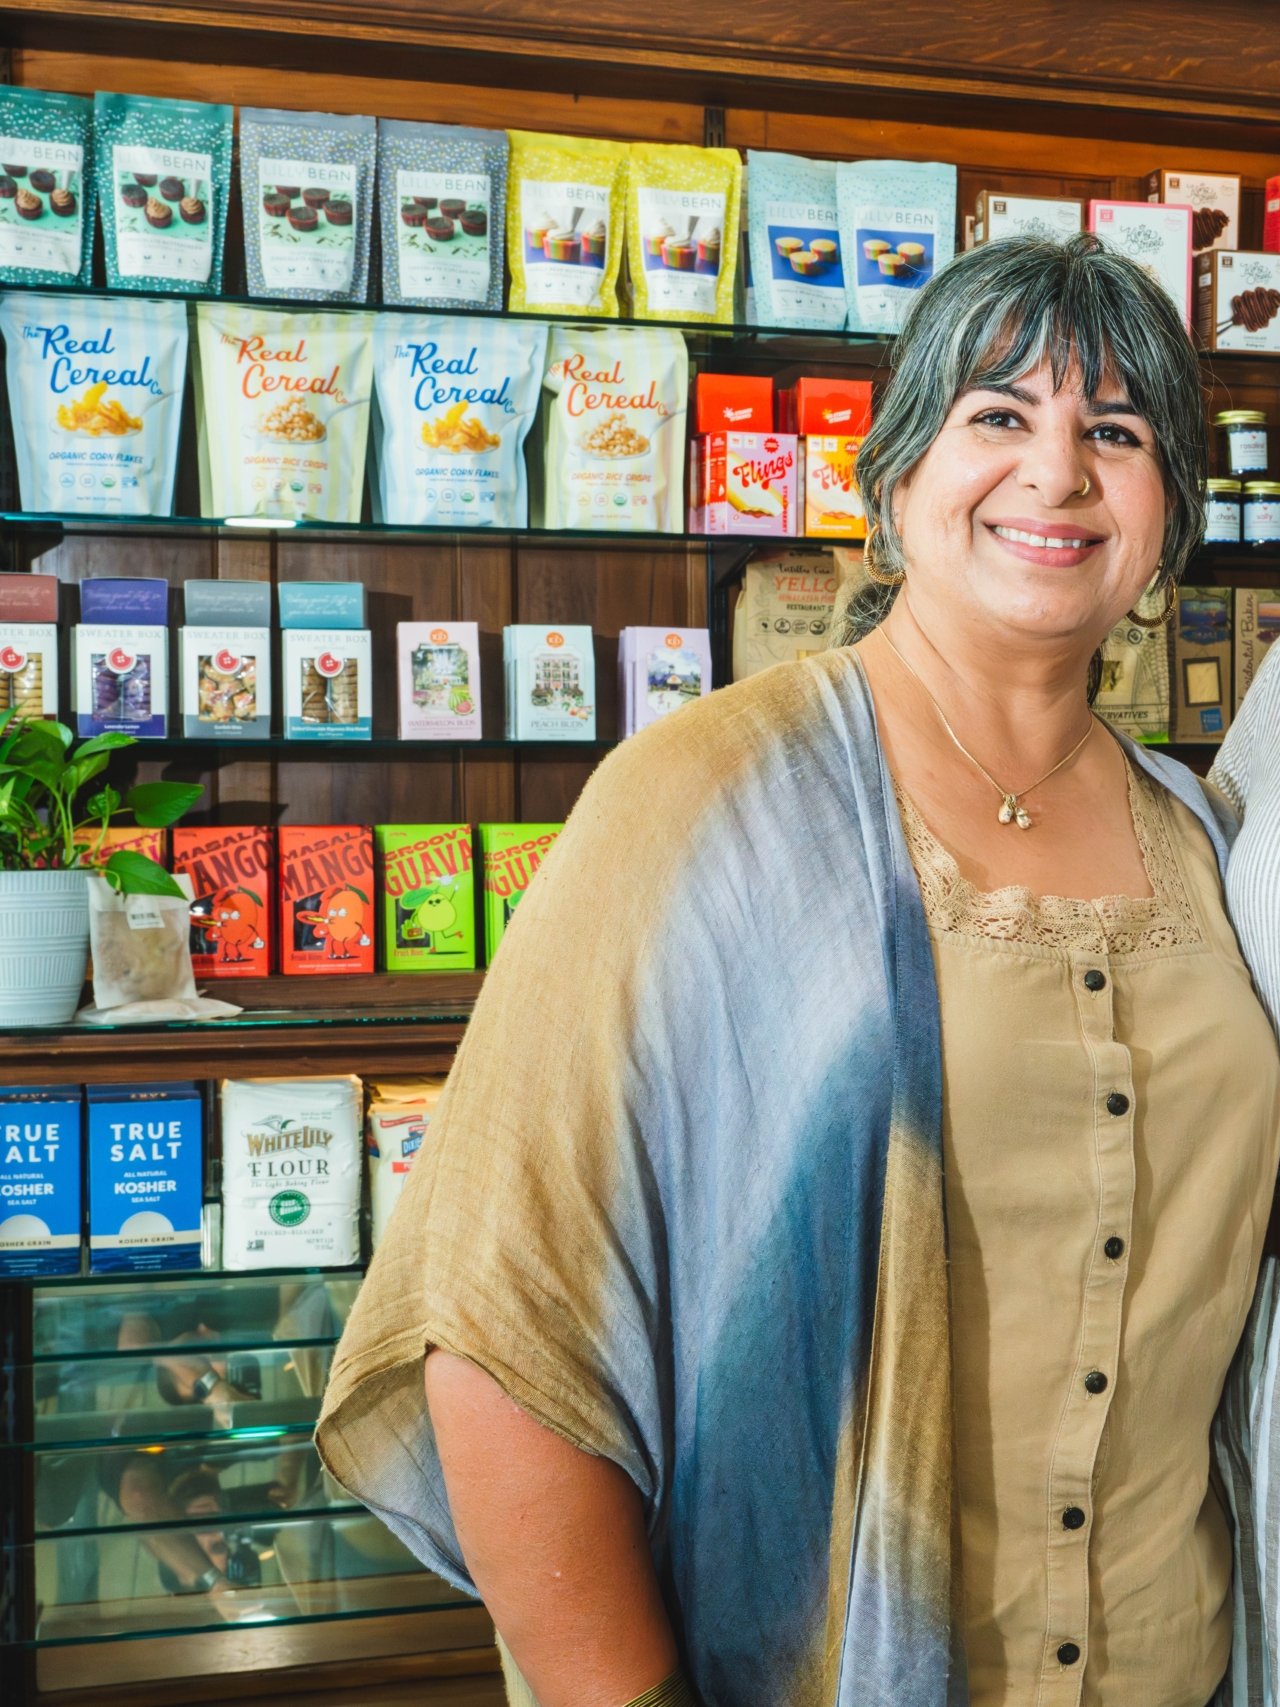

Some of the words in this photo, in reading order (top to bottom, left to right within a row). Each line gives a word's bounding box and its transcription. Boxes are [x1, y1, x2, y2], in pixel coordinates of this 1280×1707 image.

[33, 144, 80, 163] BEAN
[162, 155, 207, 172] BEAN
[308, 167, 351, 182] BEAN
[444, 178, 488, 193] BEAN
[566, 187, 607, 203] BEAN
[681, 196, 722, 209] BEAN
[895, 211, 935, 226] BEAN
[36, 323, 116, 360] Real
[235, 335, 308, 365] Real
[407, 341, 479, 378] Real
[50, 355, 153, 395] Cereal
[562, 353, 625, 384] Real
[241, 365, 338, 399] Cereal
[414, 376, 511, 412] Cereal
[566, 380, 660, 418] Cereal
[48, 451, 87, 461] ORGANIC
[89, 452, 115, 462] CORN
[115, 453, 144, 465] FLAKES
[243, 455, 279, 466] ORGANIC
[281, 457, 301, 467] RICE
[415, 467, 448, 478] ORGANIC
[450, 468, 474, 479] CORN
[475, 469, 500, 480] FLAKES
[605, 472, 624, 482] RICE
[732, 451, 794, 490] Flings
[772, 575, 838, 594] YELLO
[786, 603, 826, 612] RESTAURANT
[28, 629, 54, 638] BOX
[79, 629, 134, 639] SWEATER
[137, 630, 162, 640] BOX
[187, 631, 240, 640] SWEATER
[243, 632, 268, 641] BOX
[289, 634, 342, 644] SWEATER
[345, 635, 369, 644] BOX
[408, 718, 455, 728] WATERMELON
[457, 718, 476, 728] BUDS
[1097, 710, 1149, 720] ERVATIVES
[530, 719, 562, 729] PEACH
[563, 719, 584, 729] BUDS
[174, 825, 268, 865] MASALA
[282, 824, 373, 863] MASALA
[384, 823, 472, 863] GROOVY
[493, 832, 552, 862] GROO
[282, 838, 374, 902] MANGO
[384, 838, 473, 898] GUAVA
[0, 1123, 60, 1143] RUE
[109, 1120, 183, 1142] TRUE
[4, 1143, 60, 1164] ALT
[110, 1141, 183, 1163] SALT
[13, 1172, 44, 1180] NATURAL
[123, 1171, 136, 1179] ALL
[136, 1169, 168, 1179] NATURAL
[246, 1158, 331, 1178] FLOUR
[114, 1179, 178, 1196] KOSHER
[7, 1198, 21, 1206] SEA
[22, 1198, 37, 1206] SALT
[131, 1196, 144, 1204] SEA
[145, 1195, 161, 1203] SALT
[27, 1239, 52, 1247] GRAIN
[118, 1237, 149, 1245] KOSHER
[150, 1235, 176, 1244] GRAIN
